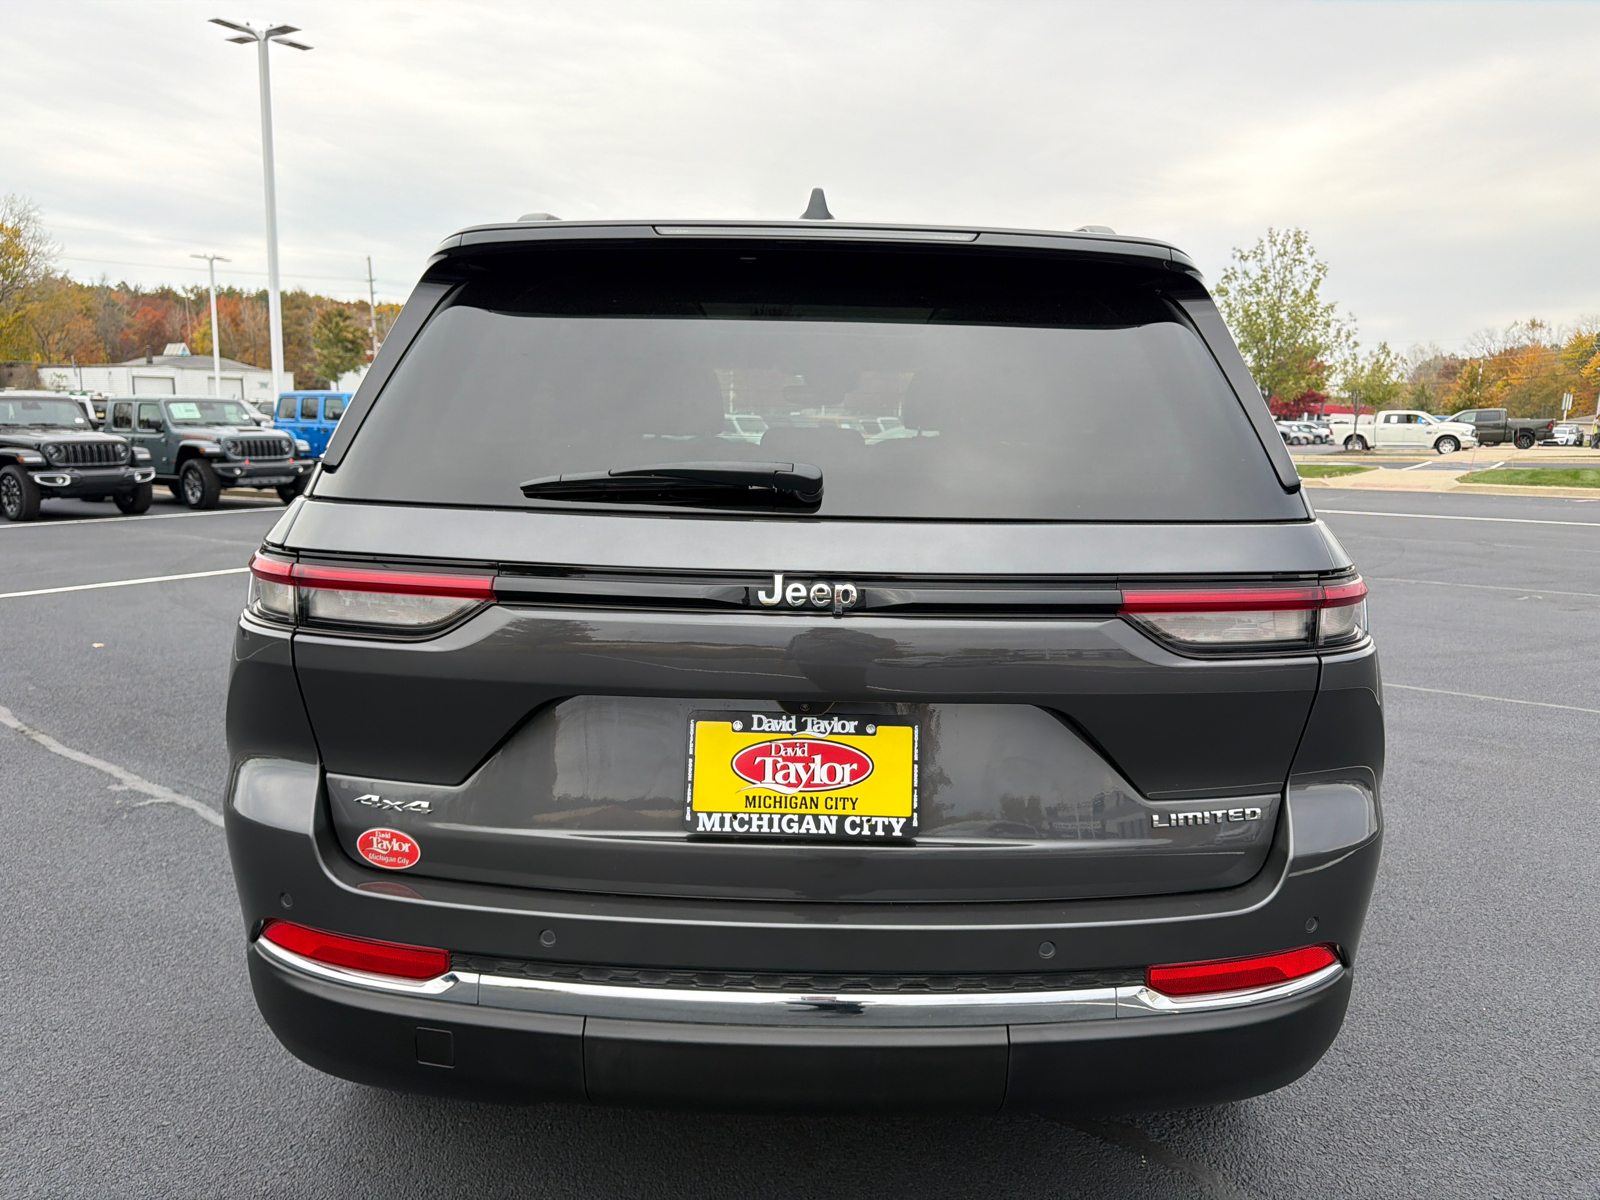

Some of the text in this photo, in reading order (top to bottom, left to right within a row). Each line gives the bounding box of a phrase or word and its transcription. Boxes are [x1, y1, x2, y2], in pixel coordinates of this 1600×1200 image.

[757, 573, 858, 615] Jeep
[751, 714, 858, 738] David Taylor
[771, 742, 808, 757] David
[736, 754, 858, 795] Taylor
[744, 795, 859, 811] MICHIGAN CITY
[696, 812, 906, 836] MICHIGAN CITY
[1151, 807, 1262, 828] LIMITED
[375, 830, 391, 839] David
[363, 836, 411, 854] Taylor
[368, 852, 410, 865] Michigan City
